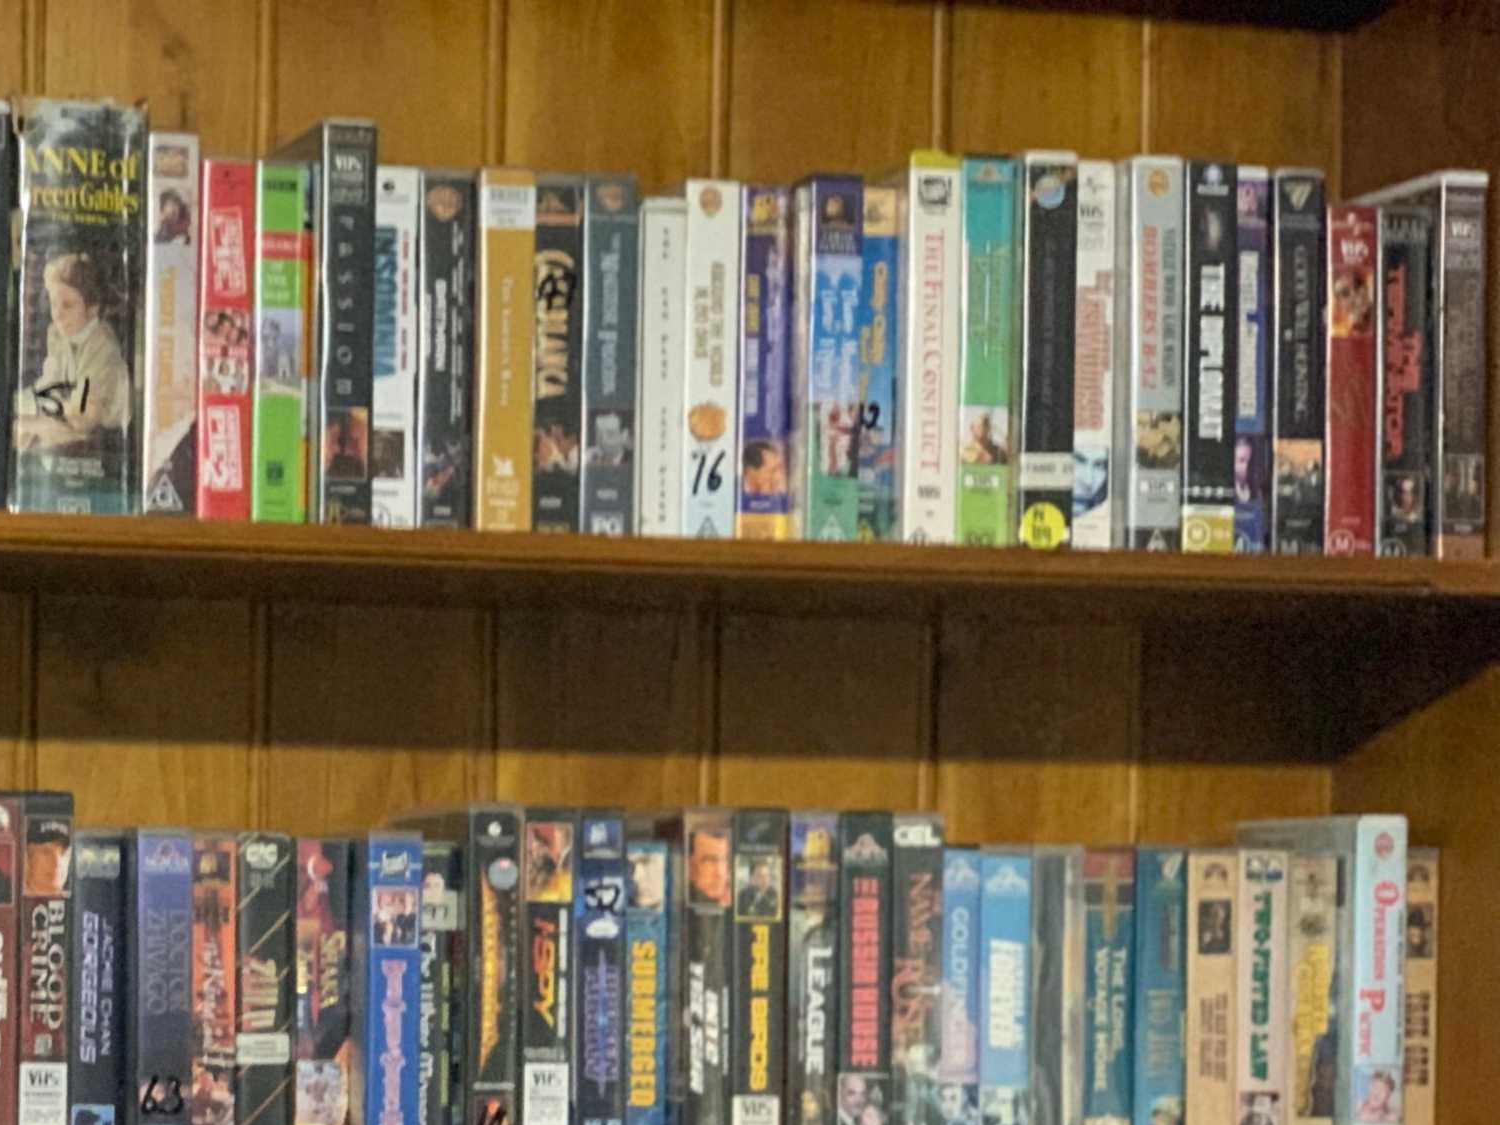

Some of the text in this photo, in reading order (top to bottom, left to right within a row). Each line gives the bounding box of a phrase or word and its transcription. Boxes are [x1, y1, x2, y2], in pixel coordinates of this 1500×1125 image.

[374, 226, 397, 377] INSOMNIA
[1385, 264, 1404, 459] TERMINATOR
[29, 903, 46, 1026] CRIME
[46, 901, 64, 1031] BLOOD
[79, 911, 99, 1065] GORGEOUS
[630, 939, 658, 1107] SUBMERGED
[751, 924, 769, 991] FIRE
[805, 946, 832, 1076] LEAGUE
